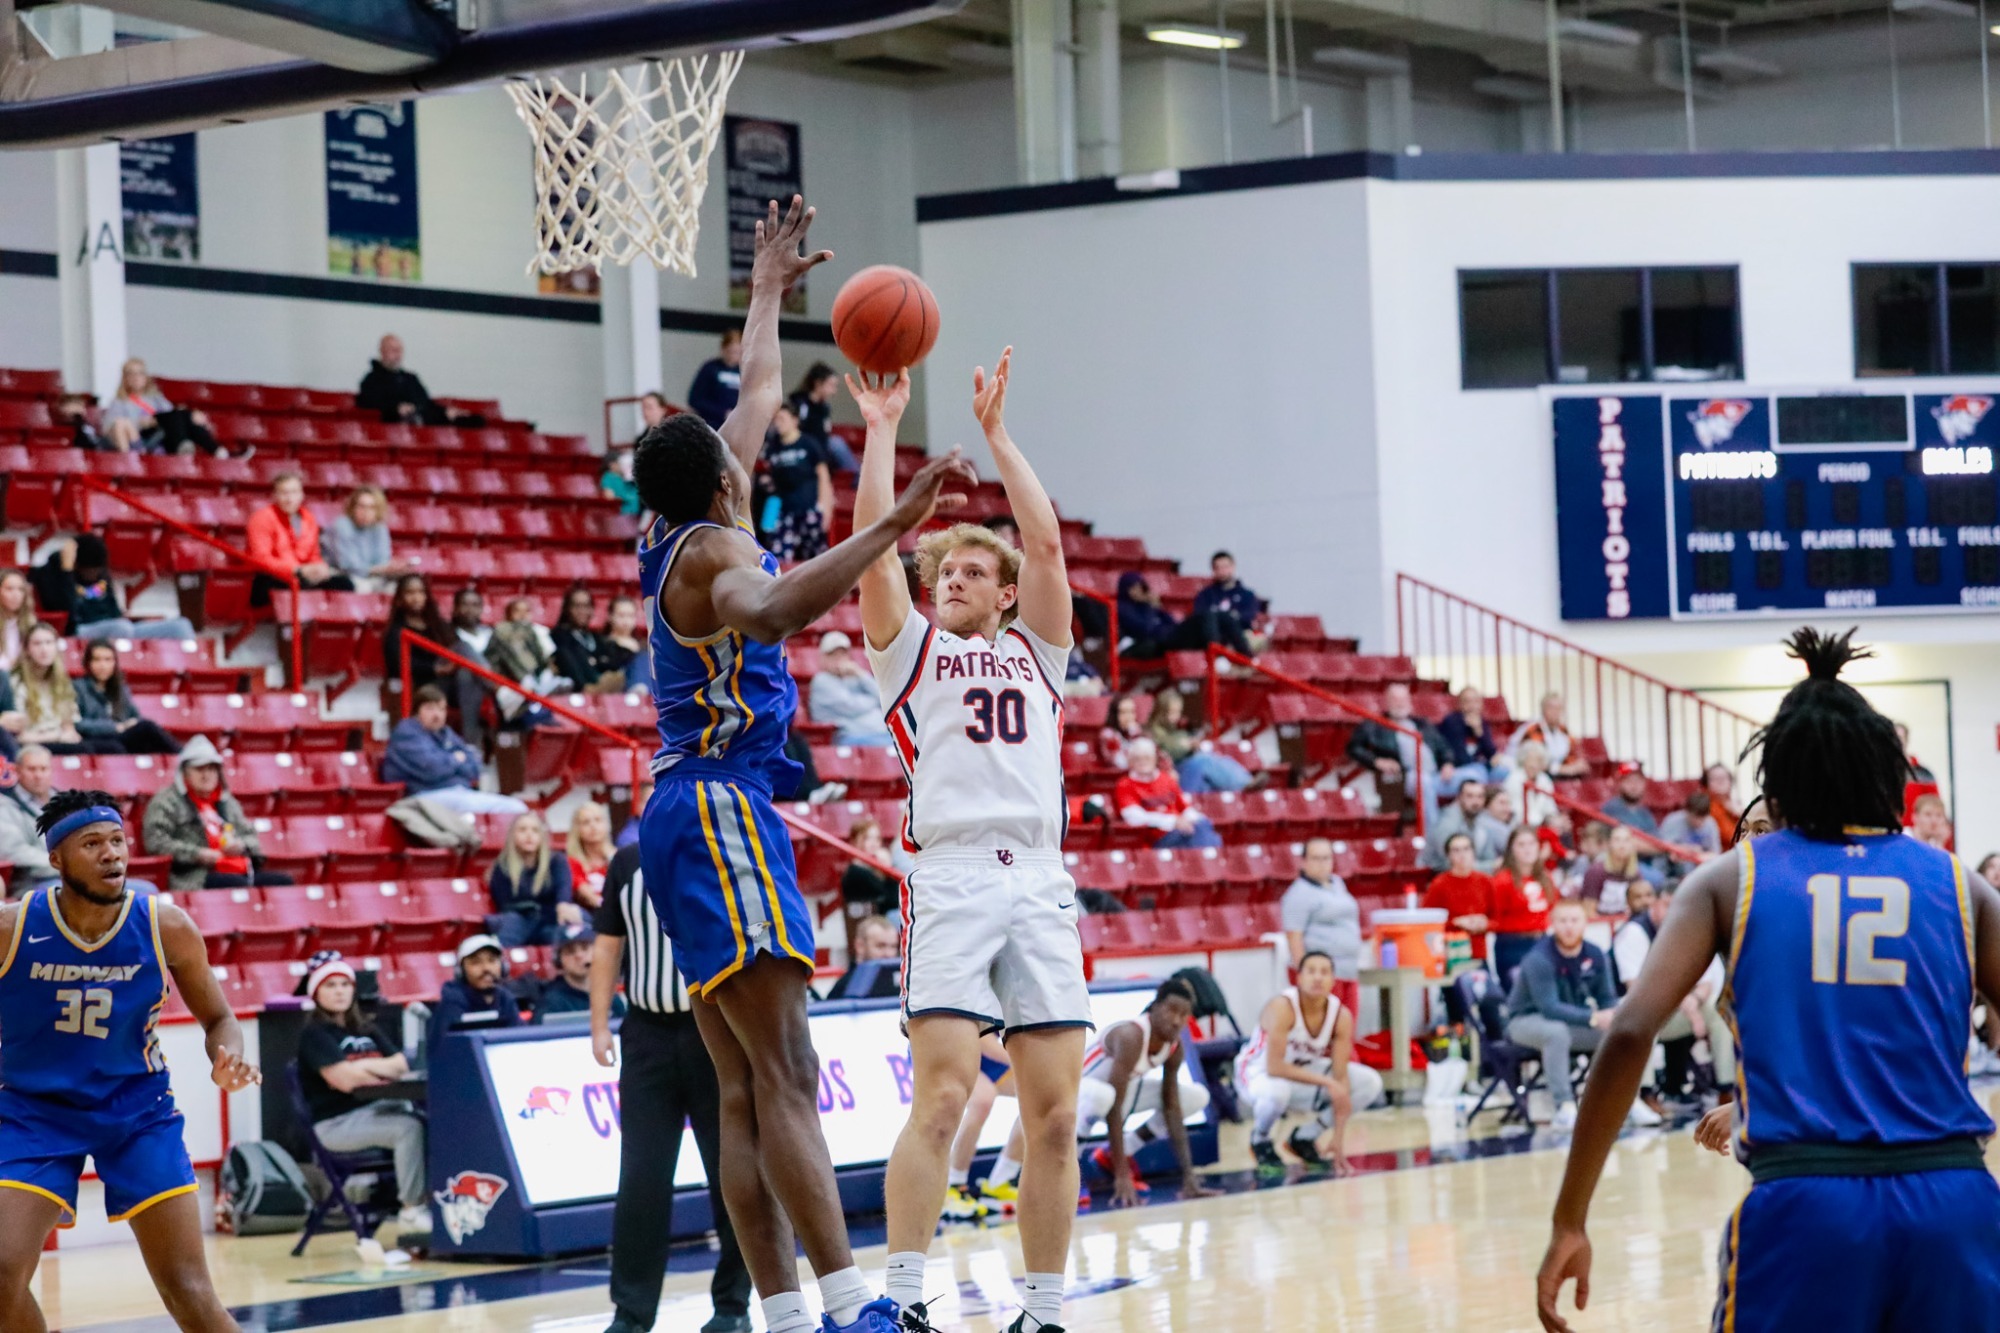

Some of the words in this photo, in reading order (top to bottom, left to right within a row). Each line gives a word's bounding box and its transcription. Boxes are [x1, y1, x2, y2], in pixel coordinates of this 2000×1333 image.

[1599, 398, 1631, 618] PATRIOTS
[1687, 531, 1735, 552] FOULS
[963, 687, 1028, 744] 30
[1807, 873, 1910, 986] 12
[30, 961, 142, 982] MIDWAY
[54, 988, 113, 1040] 32
